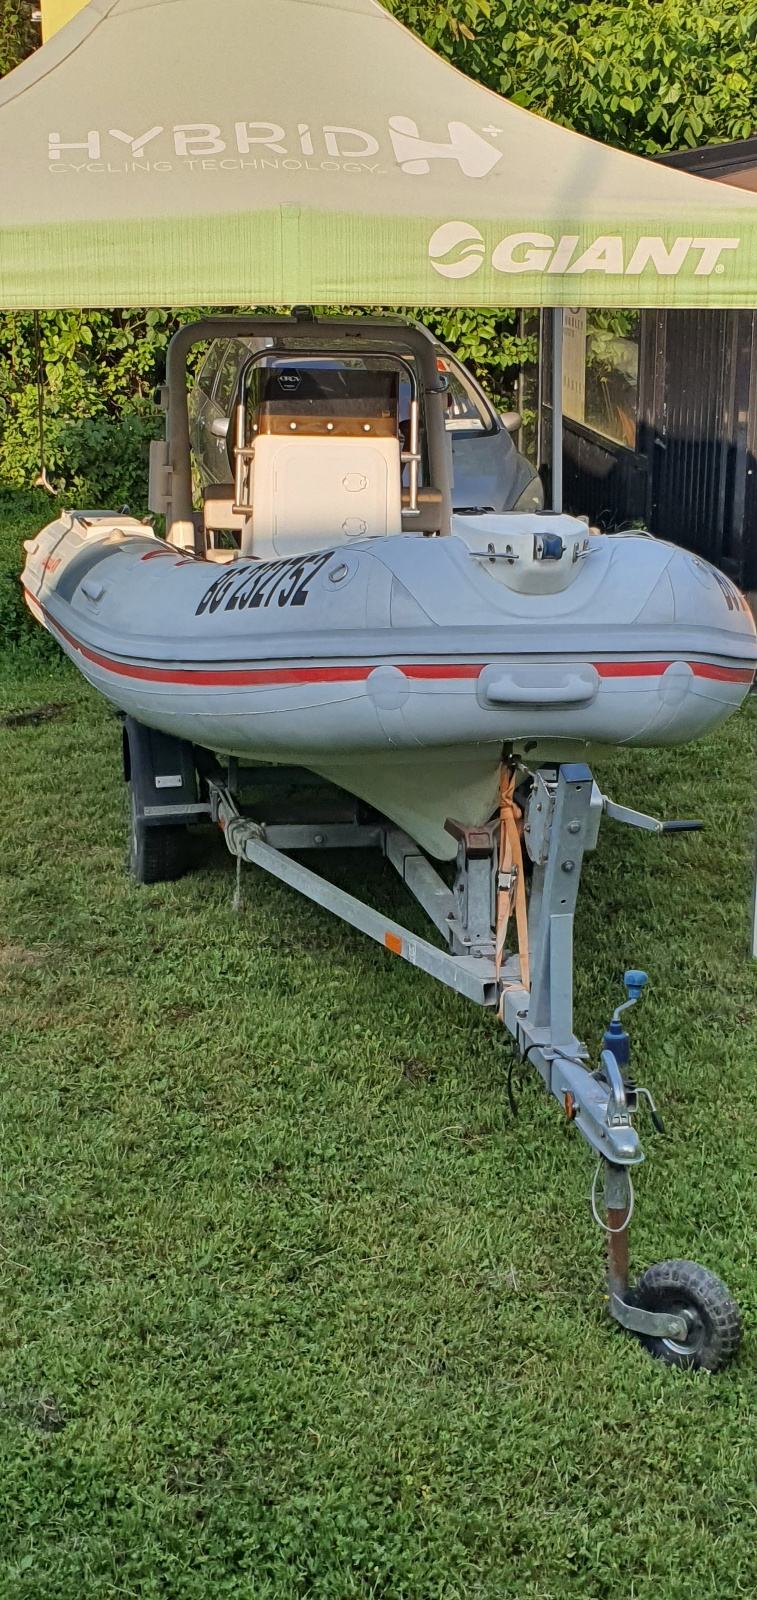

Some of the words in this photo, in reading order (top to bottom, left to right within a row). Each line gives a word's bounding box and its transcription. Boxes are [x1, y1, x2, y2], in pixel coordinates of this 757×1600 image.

[48, 121, 380, 160] HYBRID
[48, 160, 173, 174] CYCLING
[183, 158, 382, 175] TECHNOLOGY
[491, 232, 741, 275] GIANT
[195, 565, 252, 616] BG
[224, 551, 336, 611] 232752
